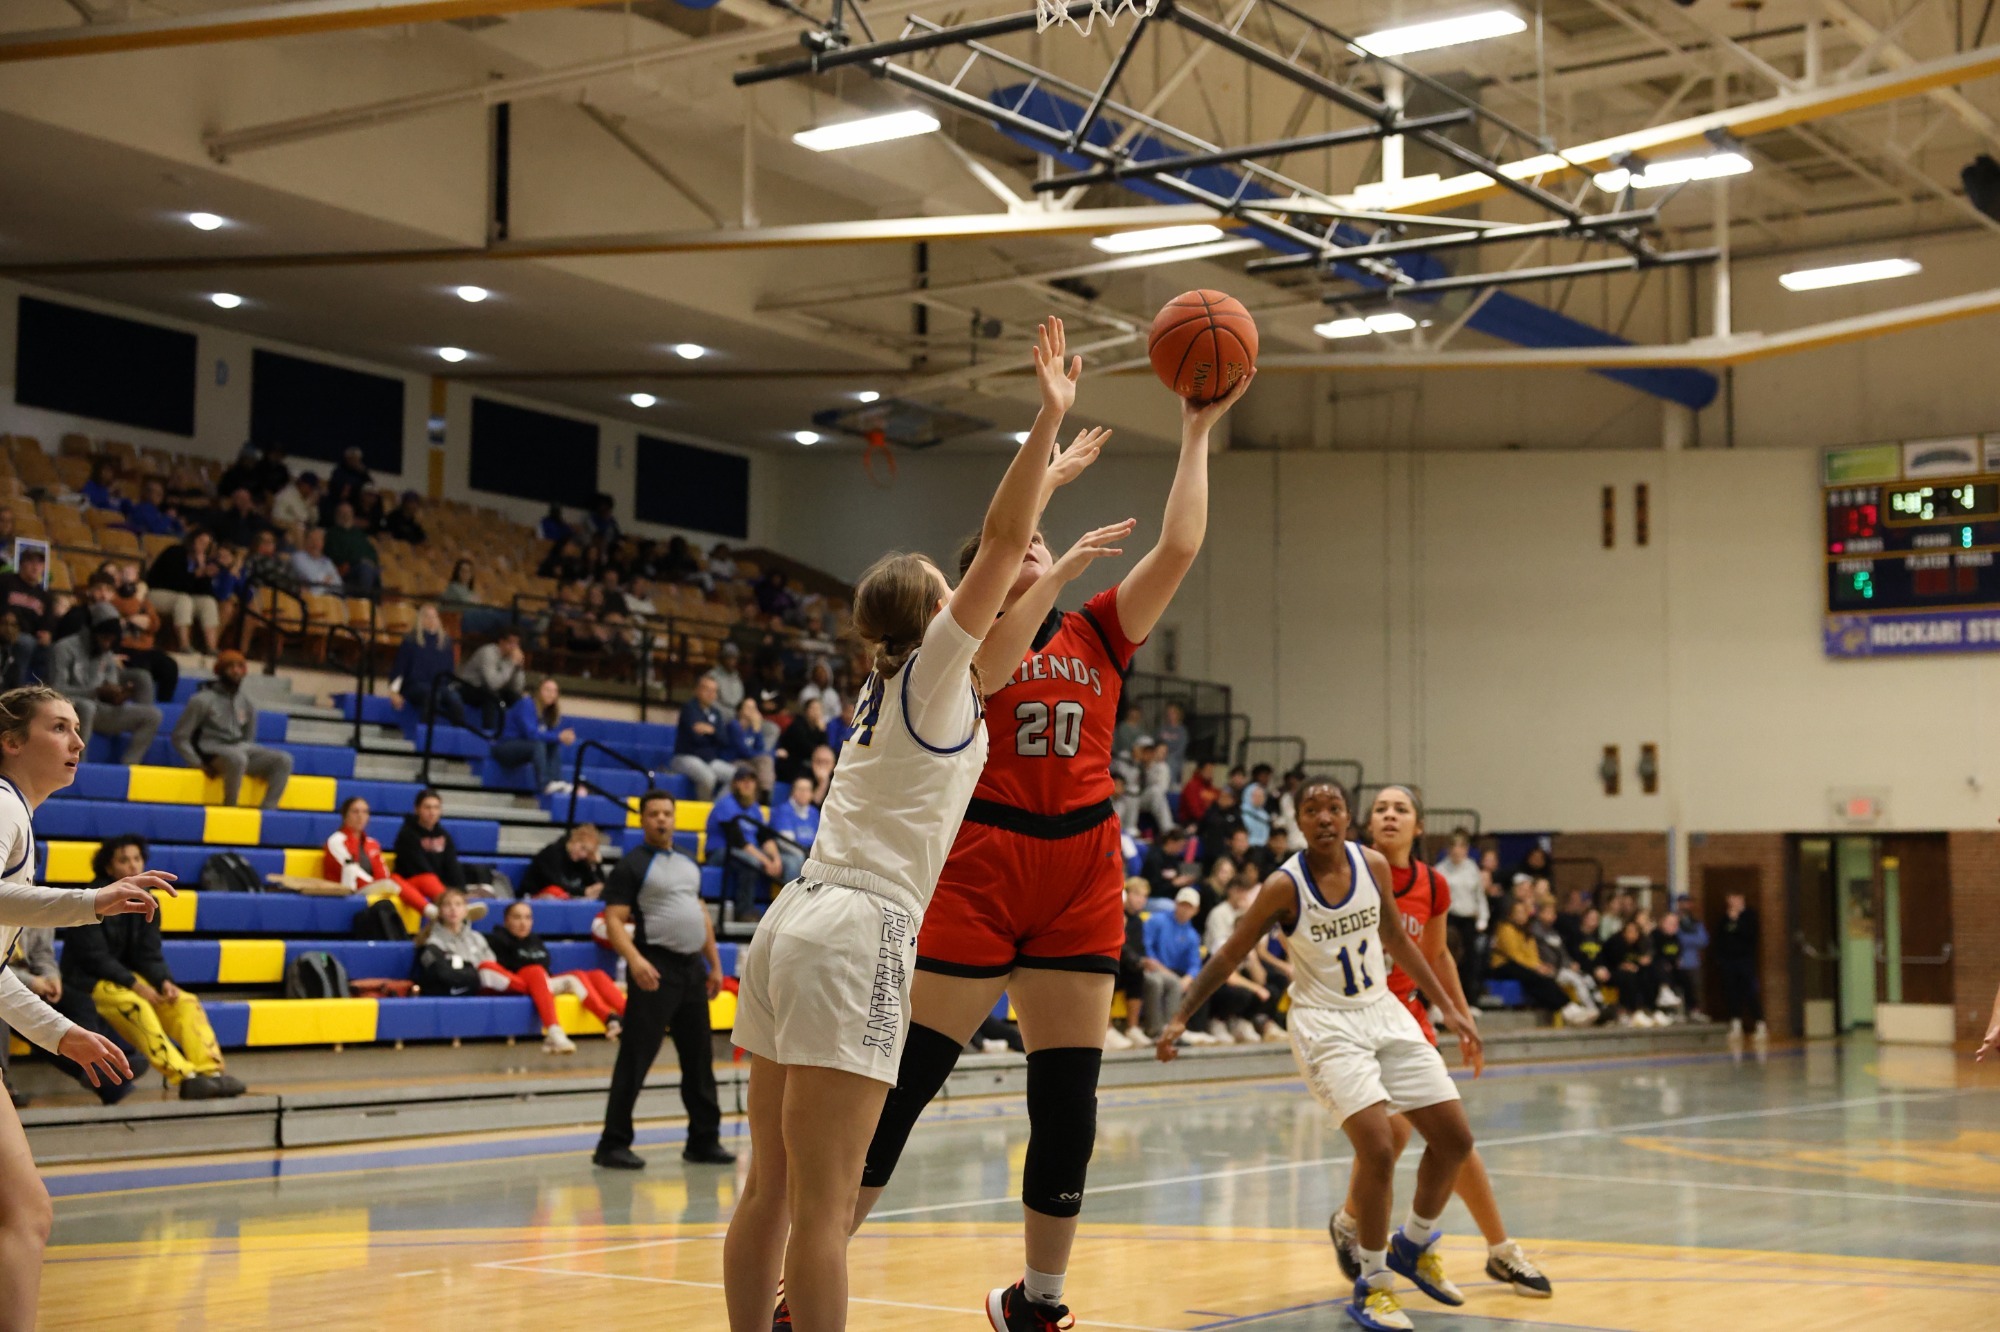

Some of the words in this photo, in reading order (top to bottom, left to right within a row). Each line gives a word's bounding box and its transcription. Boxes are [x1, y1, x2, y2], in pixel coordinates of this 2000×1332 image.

[1006, 653, 1102, 697] IENDS
[1014, 701, 1084, 757] 20
[1310, 906, 1377, 943] SWEDES
[862, 906, 911, 1058] BETHANY
[1336, 939, 1374, 997] 11
